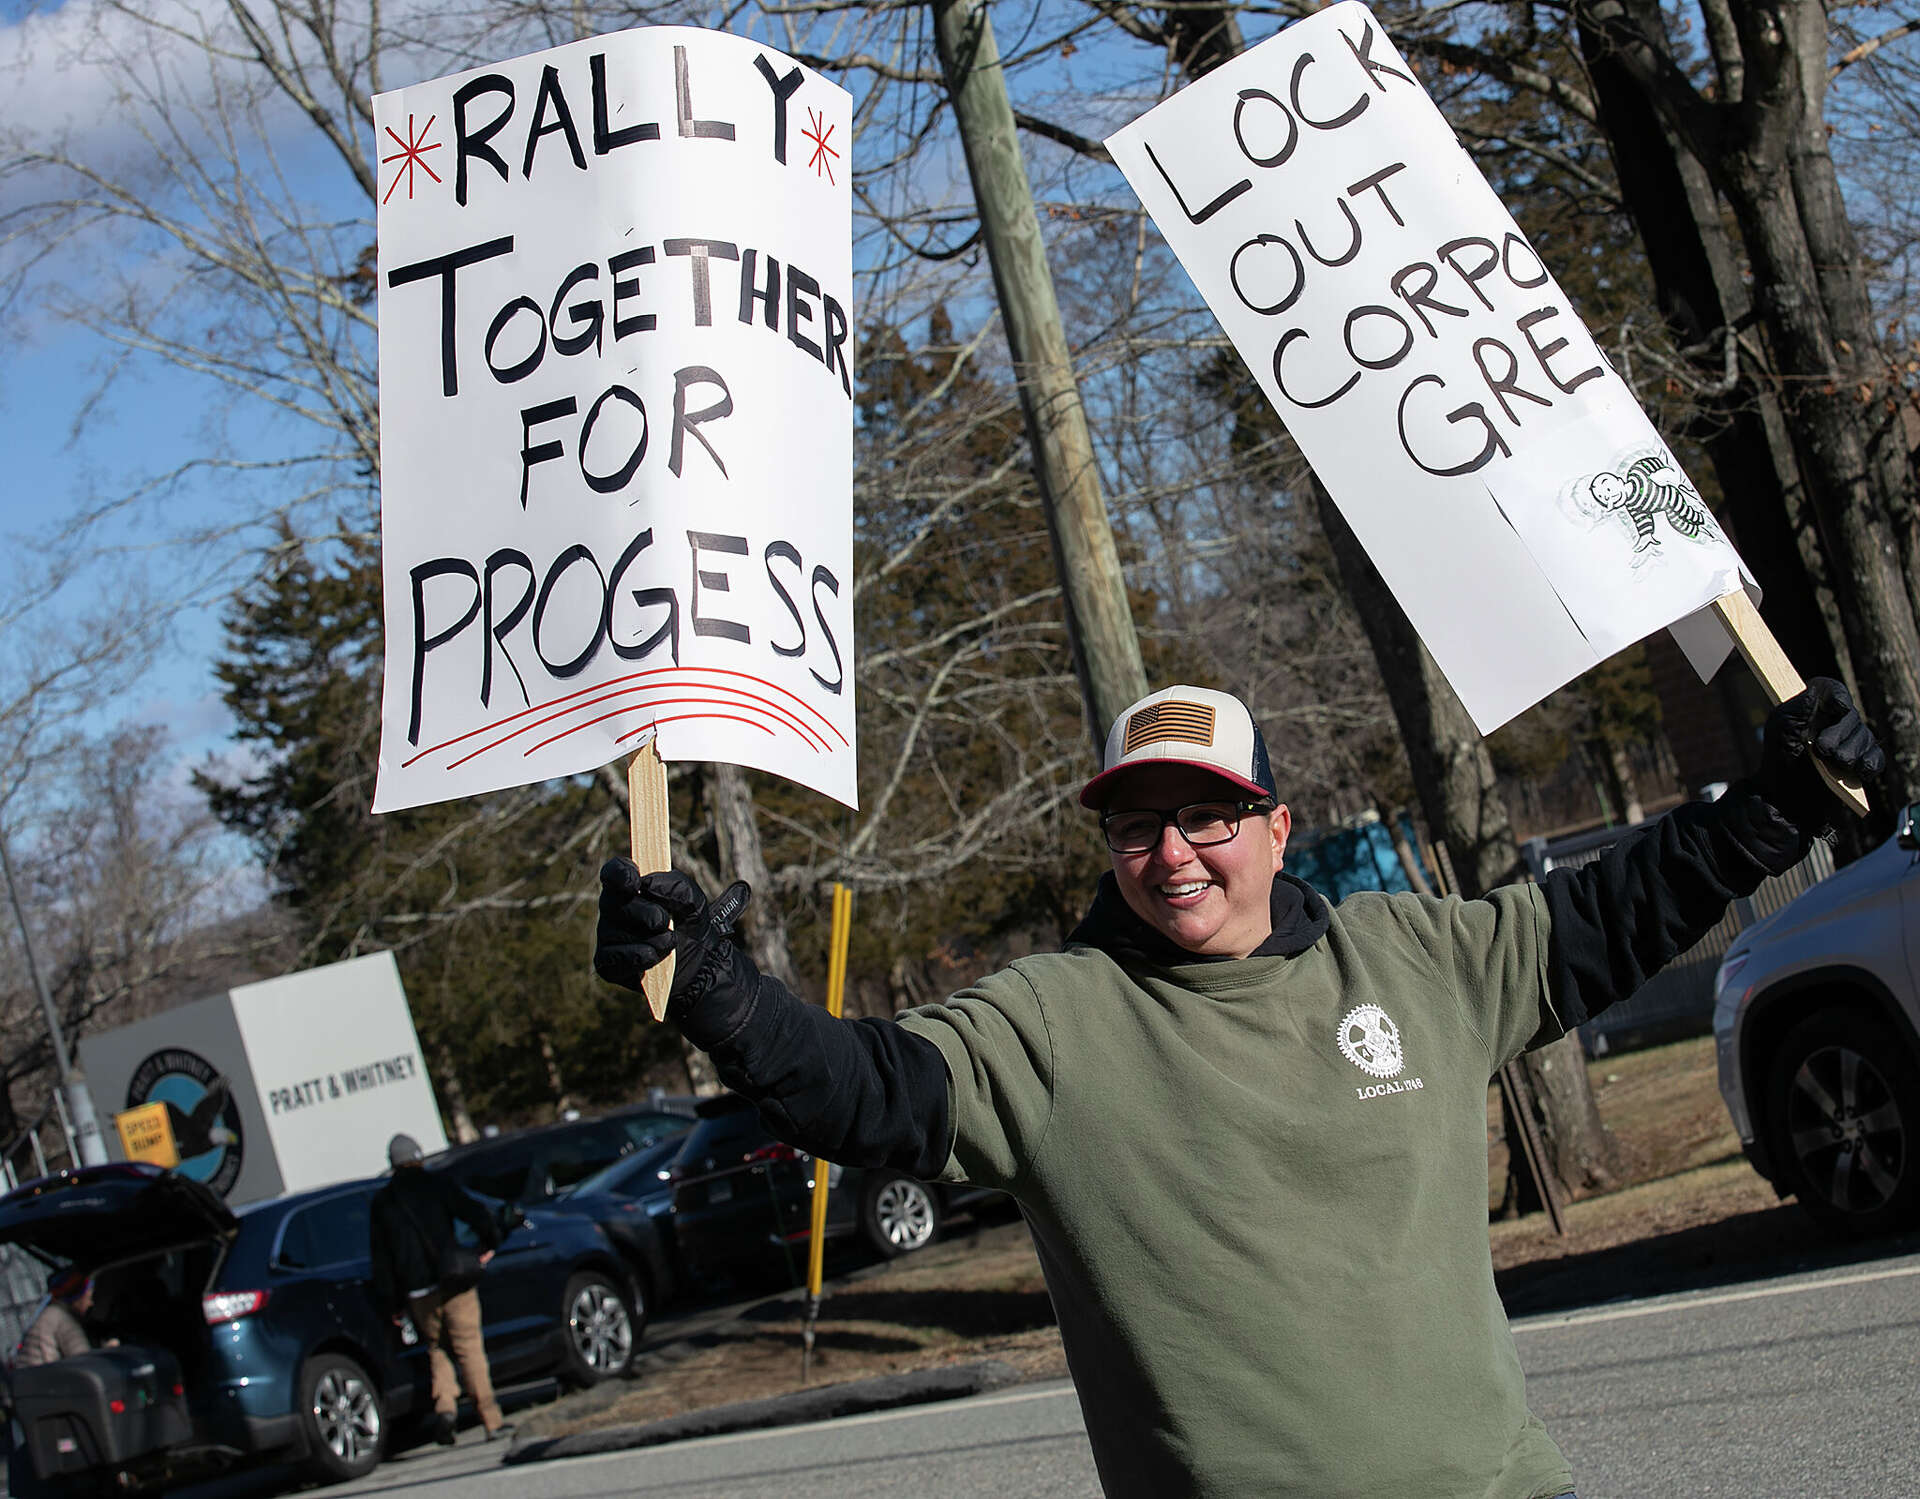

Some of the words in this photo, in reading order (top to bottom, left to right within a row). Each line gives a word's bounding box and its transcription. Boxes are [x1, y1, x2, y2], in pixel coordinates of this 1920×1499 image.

[452, 45, 805, 207] RALLY
[1144, 18, 1416, 225] LOCK
[388, 235, 852, 400] TOGETHER
[1230, 162, 1407, 315] OUT
[1273, 232, 1549, 409] CORPO
[1398, 306, 1605, 477] GRE
[520, 366, 733, 511] FOR
[407, 528, 843, 746] PROGESS
[269, 1078, 324, 1115] PRATT
[327, 1074, 340, 1099] &
[341, 1053, 416, 1096] WHITNEY
[1356, 1081, 1405, 1100] LOCAL
